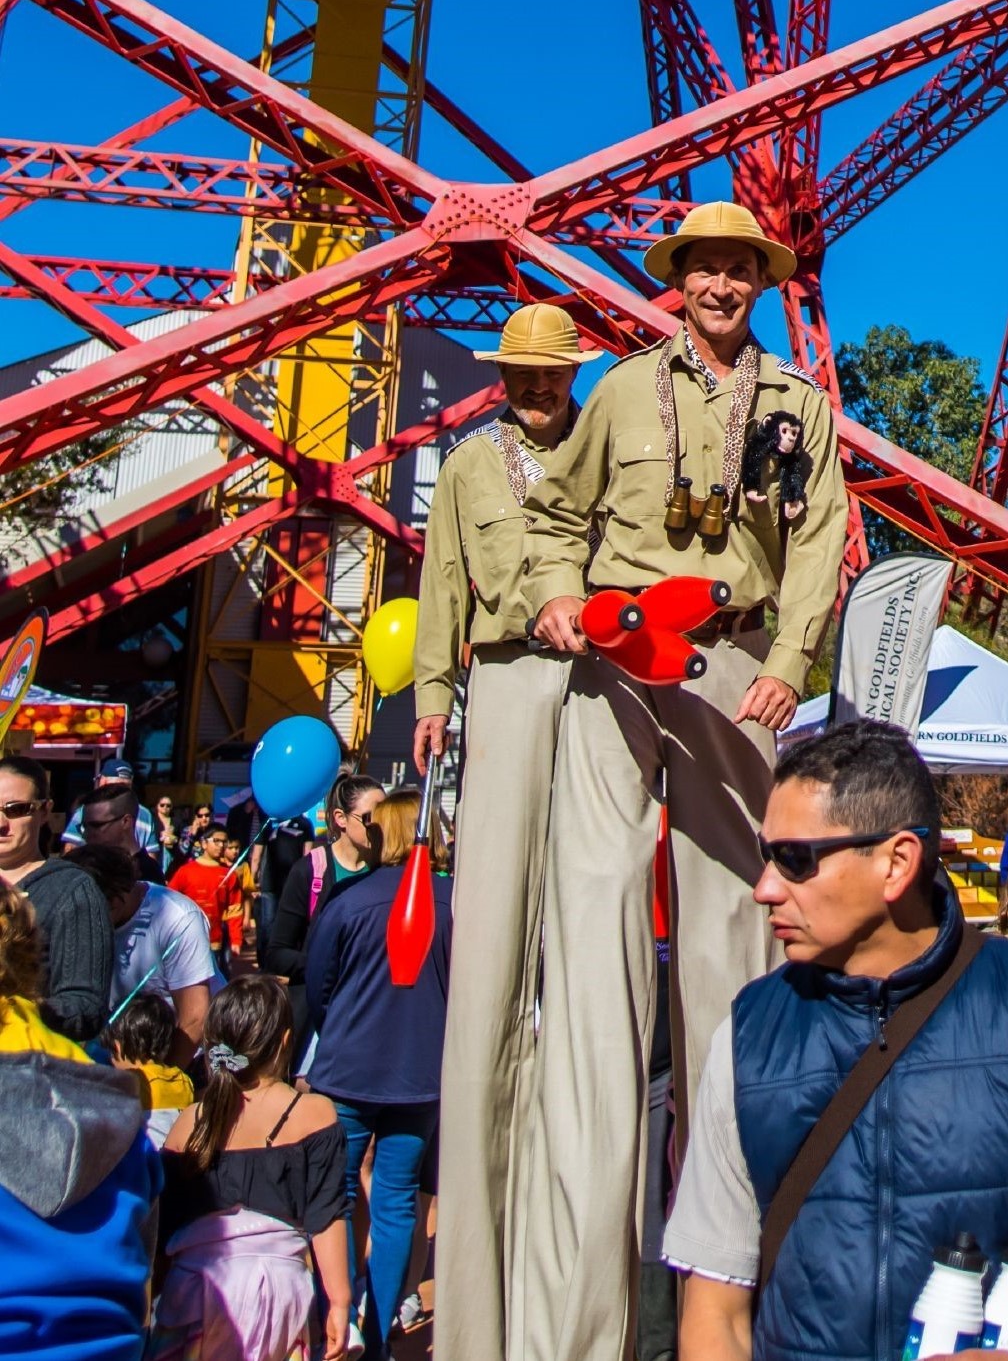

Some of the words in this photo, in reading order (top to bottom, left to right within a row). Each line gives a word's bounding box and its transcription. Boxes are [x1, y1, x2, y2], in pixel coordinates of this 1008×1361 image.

[869, 596, 900, 700] GOLDFIELDS
[888, 605, 912, 677] SOCIETY
[903, 571, 923, 604] INC.
[936, 732, 1008, 744] GOLDFIELDS
